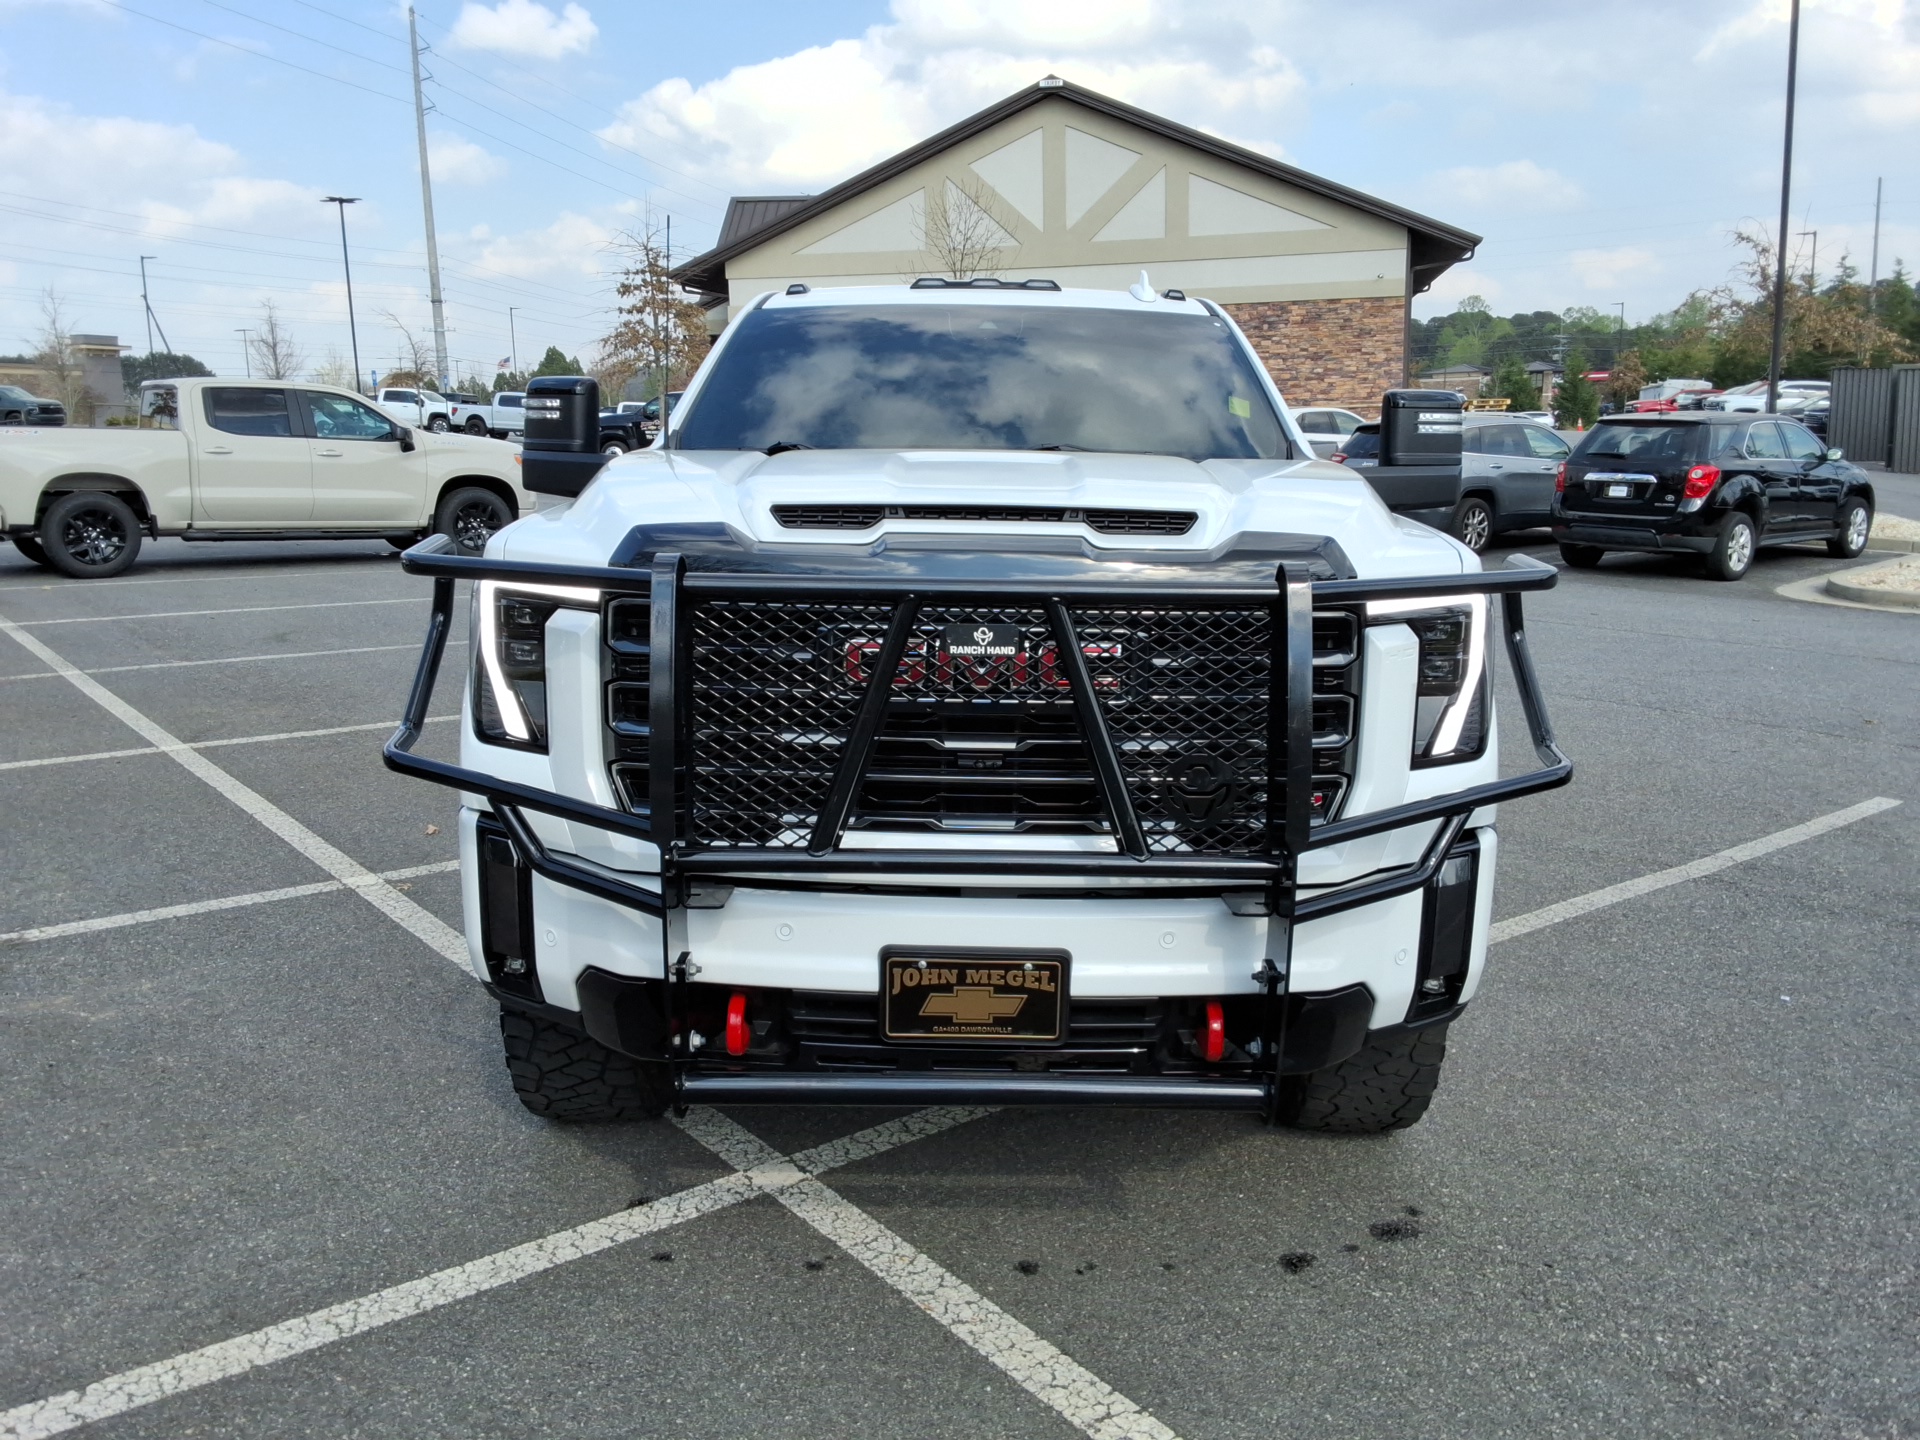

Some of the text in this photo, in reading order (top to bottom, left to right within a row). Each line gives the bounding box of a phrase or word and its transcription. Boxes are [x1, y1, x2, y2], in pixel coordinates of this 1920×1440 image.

[949, 645, 1016, 655] RANCH HAND
[892, 967, 1055, 995] JOHN MEGEL
[960, 1026, 1013, 1034] DAWSONVILLE
